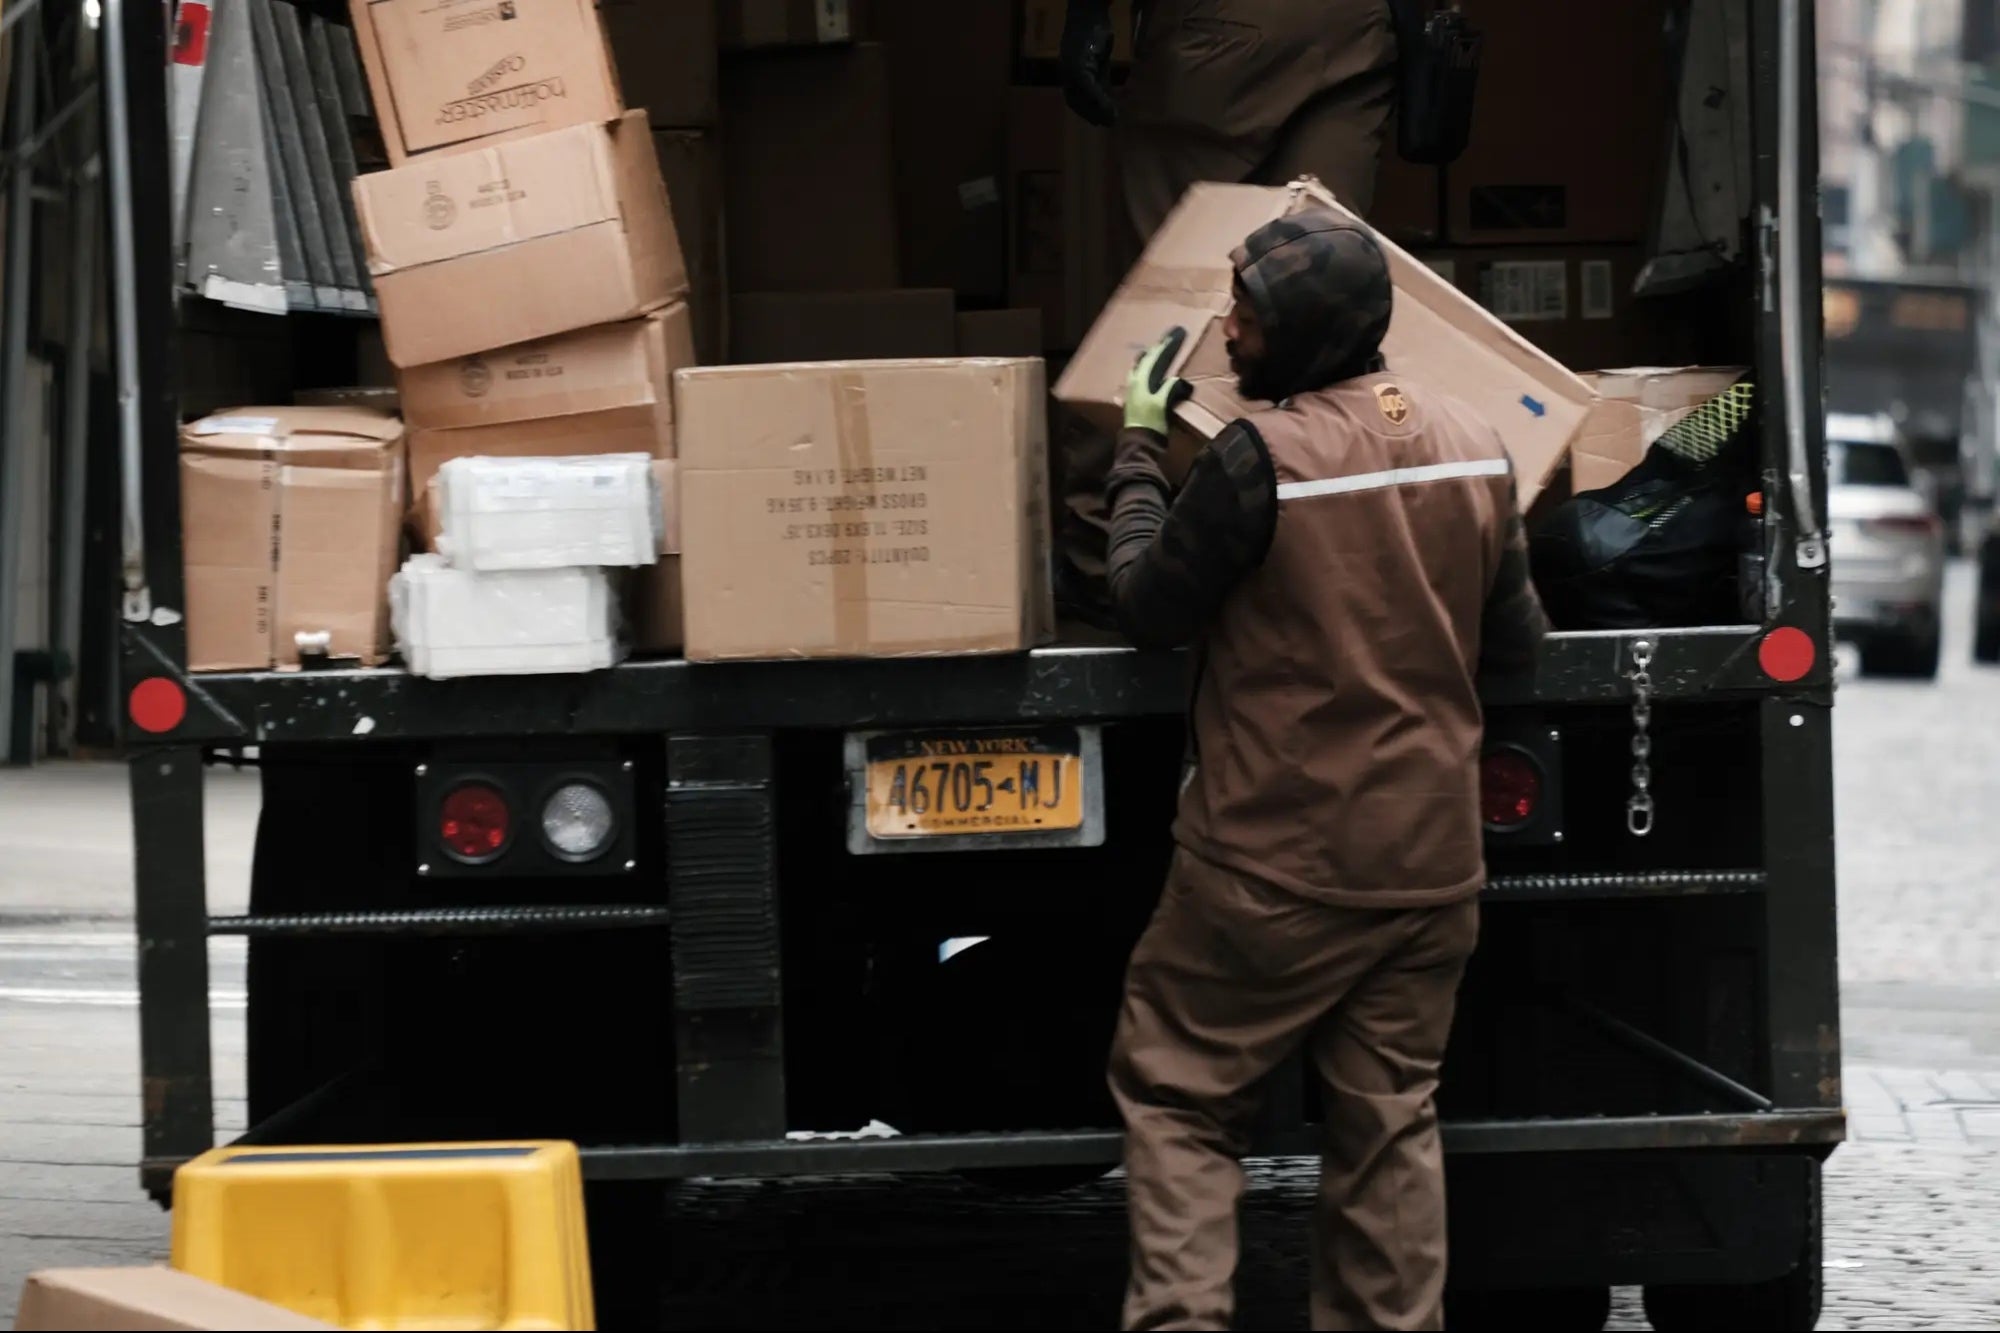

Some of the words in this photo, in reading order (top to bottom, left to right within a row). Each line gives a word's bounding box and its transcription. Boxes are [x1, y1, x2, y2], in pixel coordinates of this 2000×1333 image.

[1379, 394, 1406, 418] ups
[901, 466, 927, 482] NET
[881, 493, 927, 510] GROSS
[920, 739, 969, 754] NEW
[974, 738, 1030, 753] YORK
